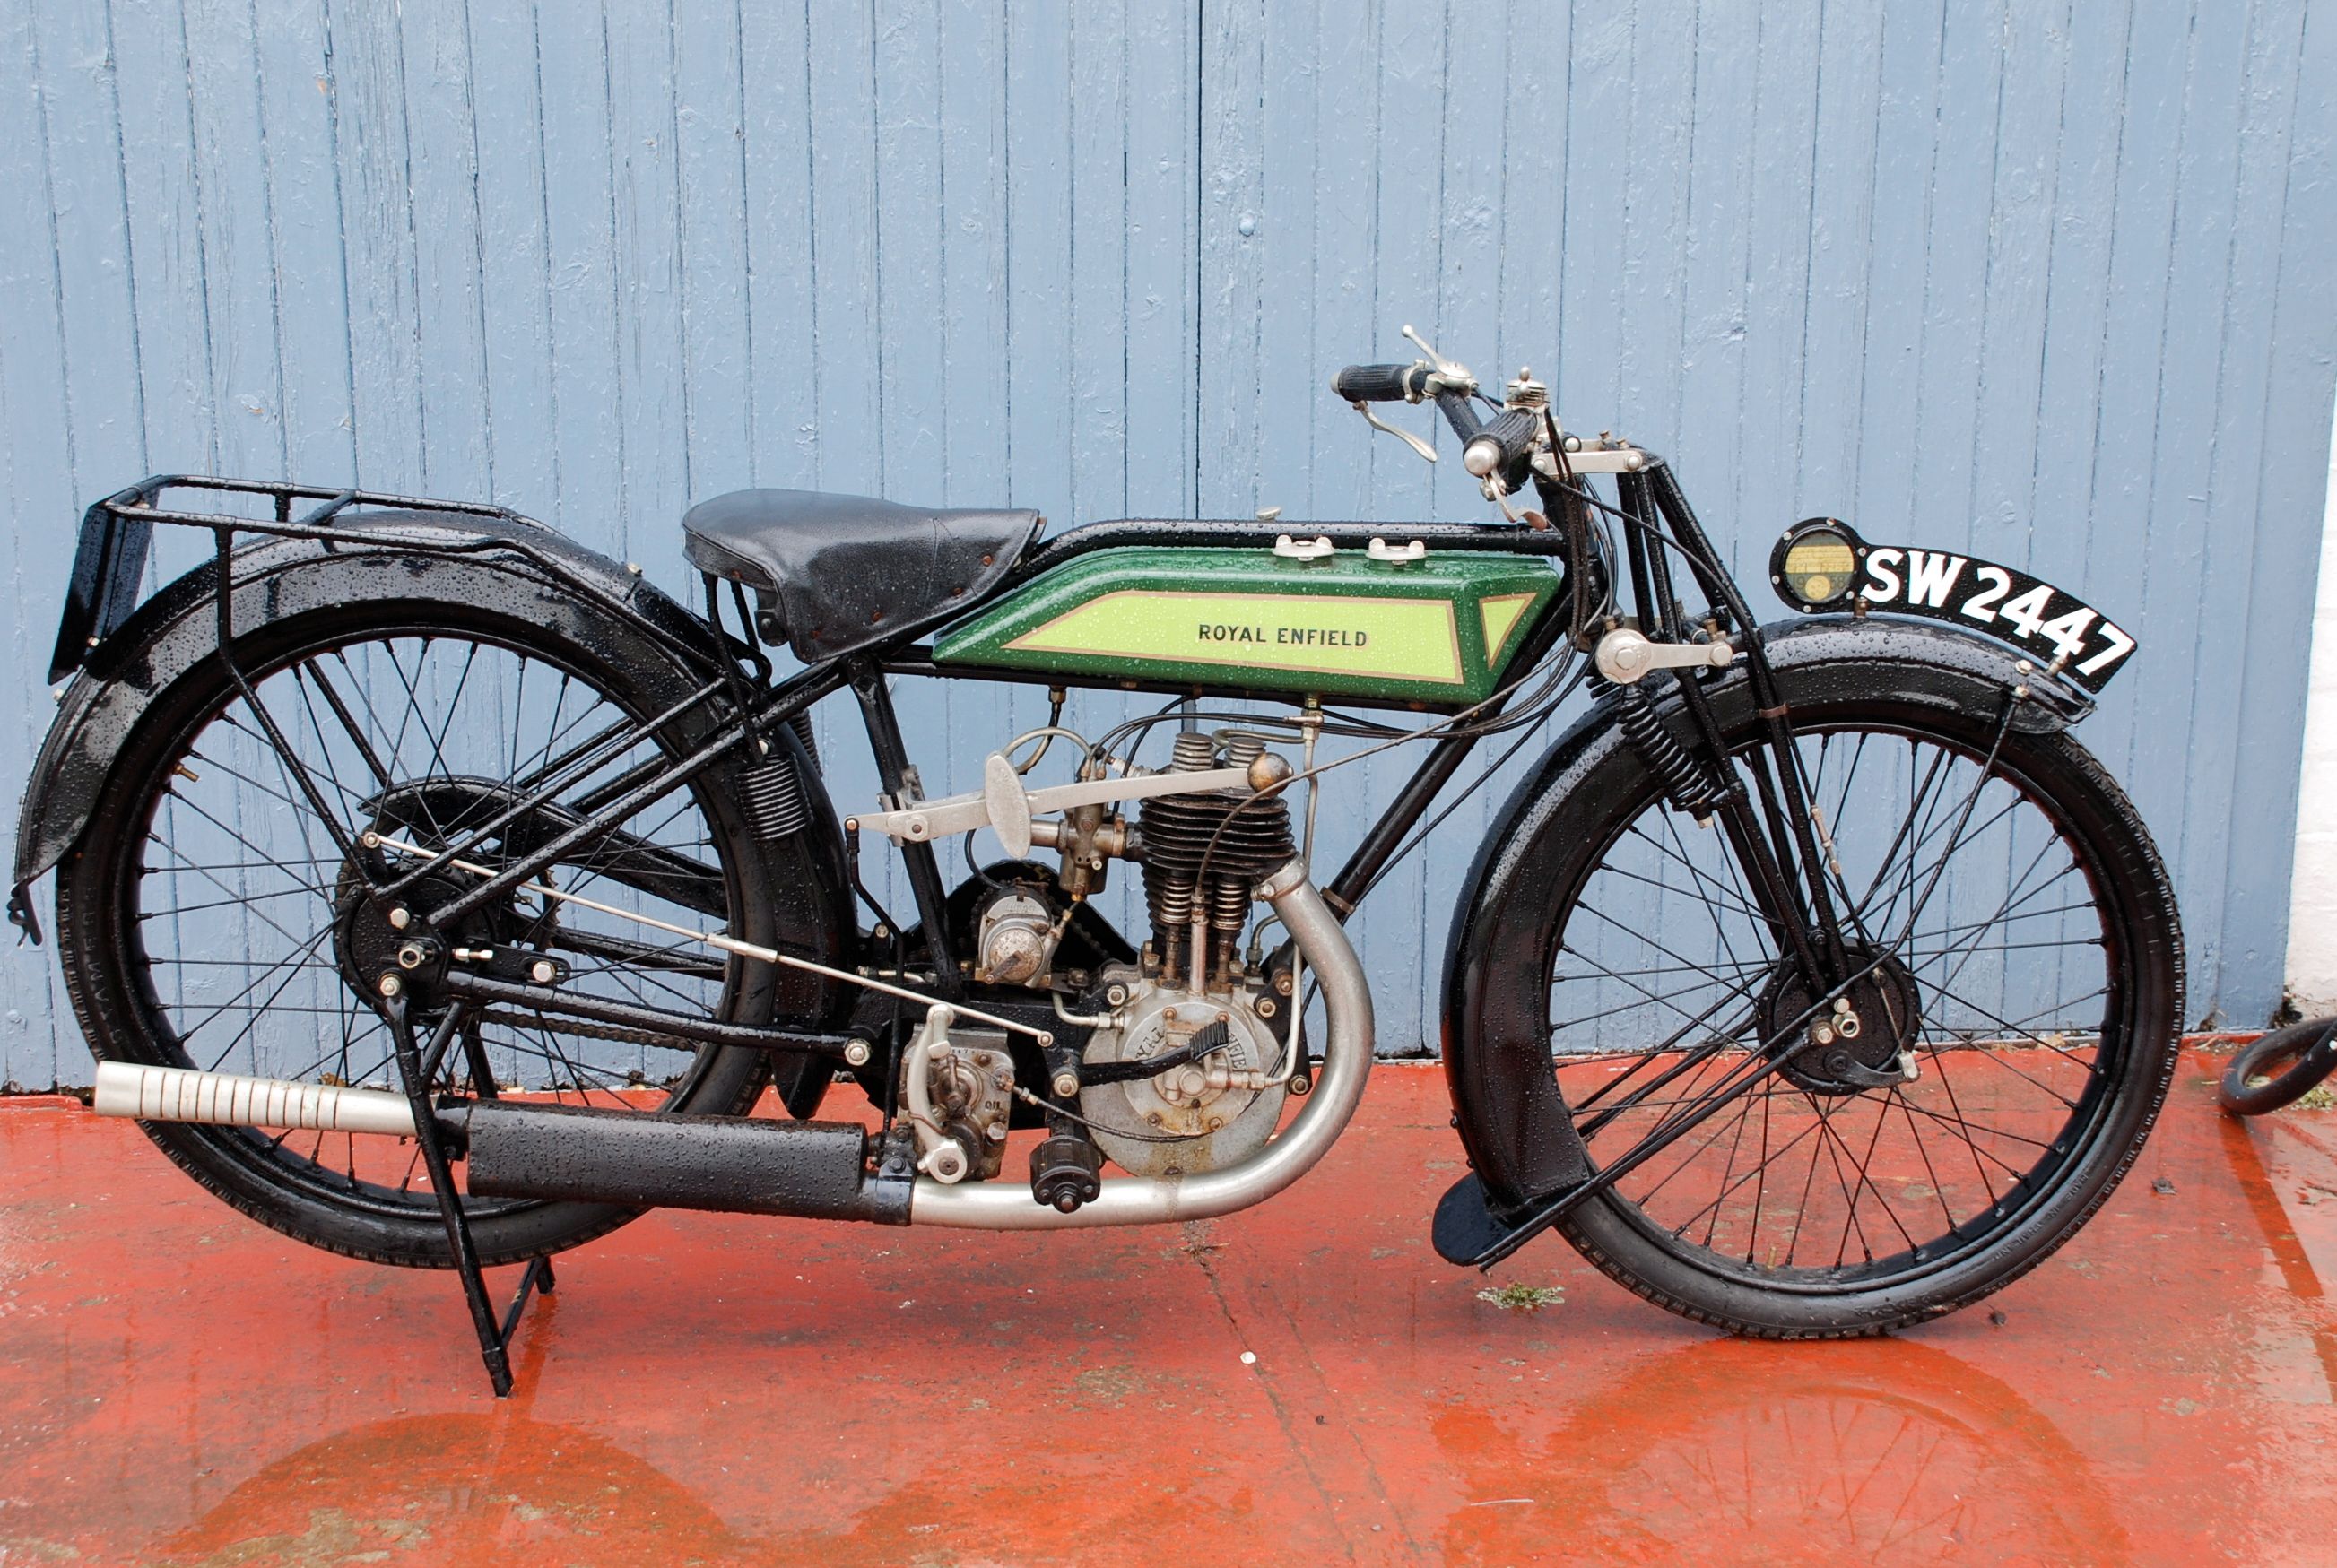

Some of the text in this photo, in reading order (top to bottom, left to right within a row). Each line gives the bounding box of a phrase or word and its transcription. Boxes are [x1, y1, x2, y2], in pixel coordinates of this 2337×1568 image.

[1860, 548, 2136, 677] SW 2447
[1198, 624, 1368, 647] ROYAL ENFIELD
[1135, 1027, 1165, 1059] YAL
[984, 1100, 1002, 1111] OIL
